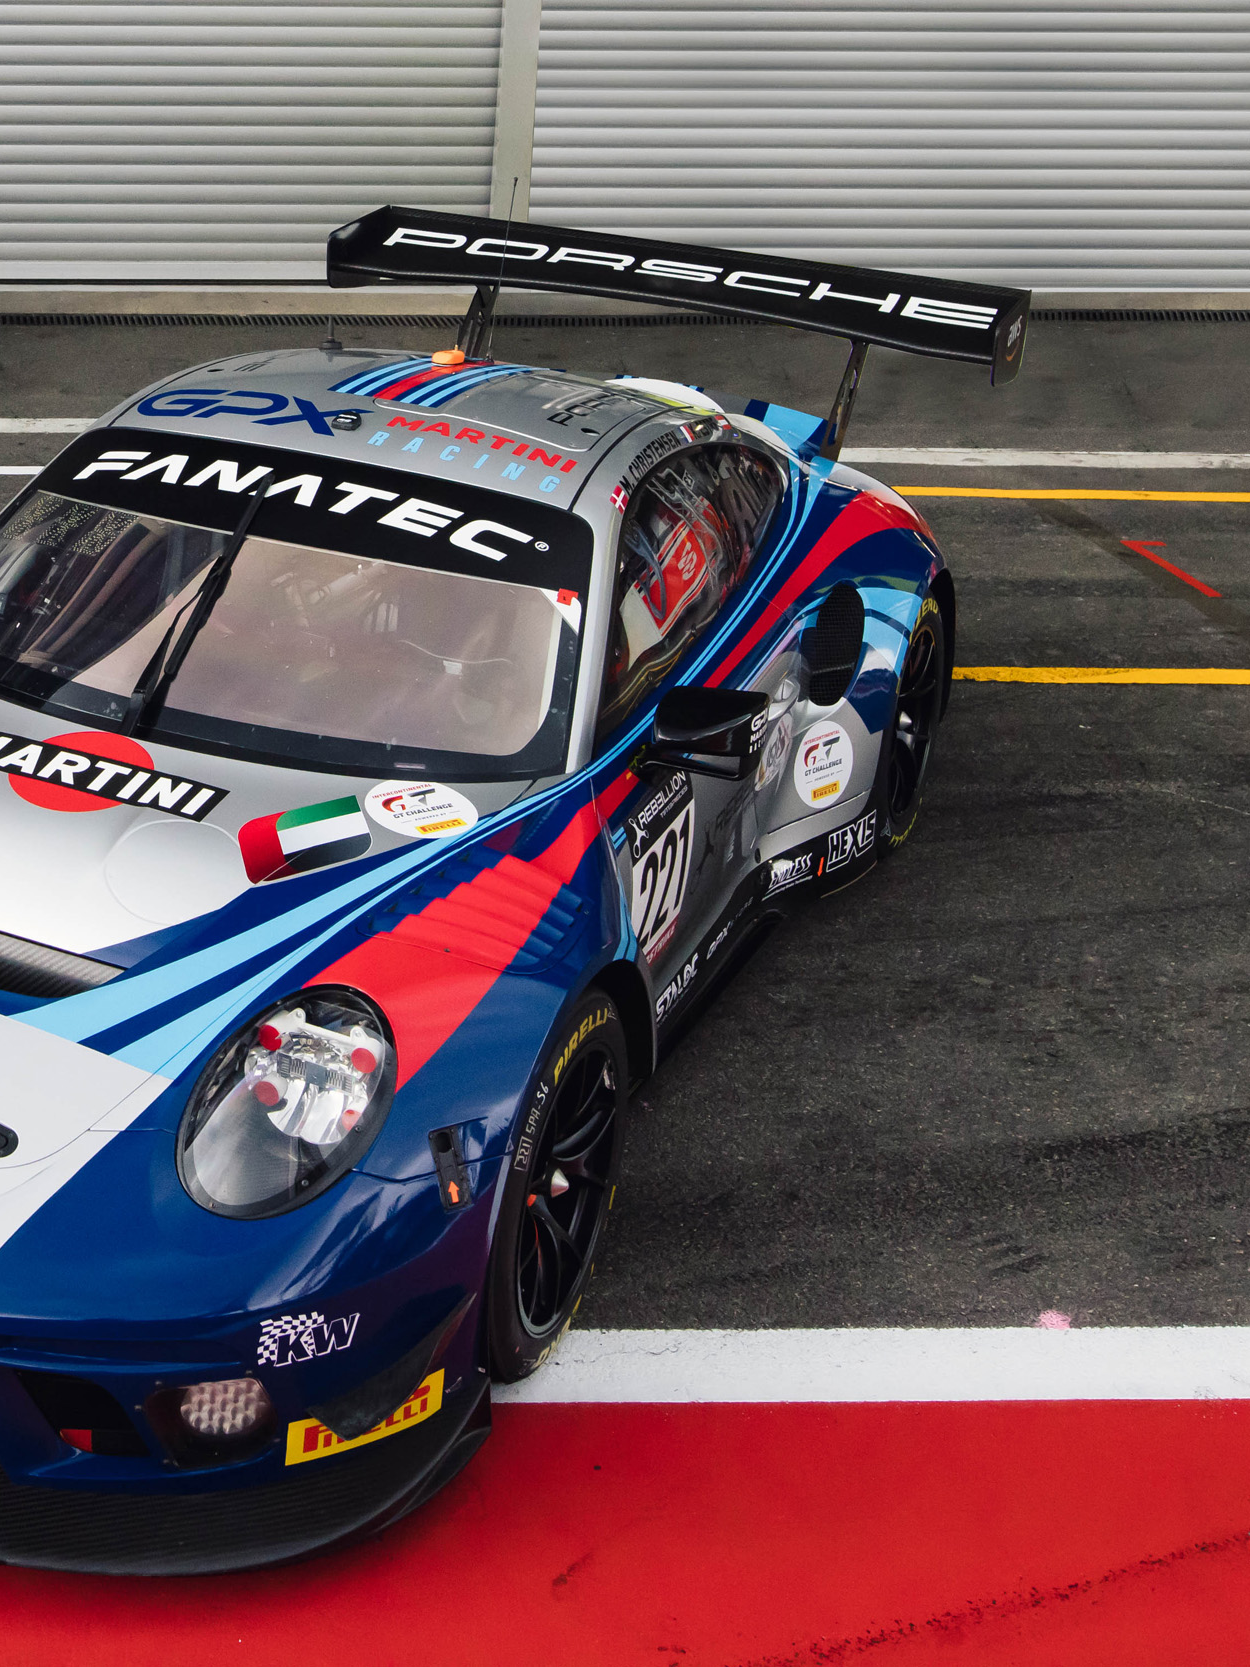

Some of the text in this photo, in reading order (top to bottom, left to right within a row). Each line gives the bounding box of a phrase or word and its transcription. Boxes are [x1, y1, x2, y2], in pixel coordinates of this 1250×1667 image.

[383, 228, 999, 331] PORSCHE
[137, 389, 374, 437] GPX
[367, 430, 560, 493] RACING
[386, 416, 579, 473] MARTINI
[628, 429, 682, 480] CHRISTENSEN
[371, 783, 433, 799] INTERCONTINENTAL
[805, 758, 843, 777] GT CHALLENGE
[813, 782, 838, 799] PIRELLI
[406, 803, 454, 817] CHALLENGE
[419, 819, 463, 833] PIRELLI
[637, 770, 687, 830] REBELLION
[825, 809, 877, 873] HEXIS
[636, 808, 690, 950] 221
[553, 1007, 608, 1087] PIRELLI
[273, 1312, 361, 1367] KW
